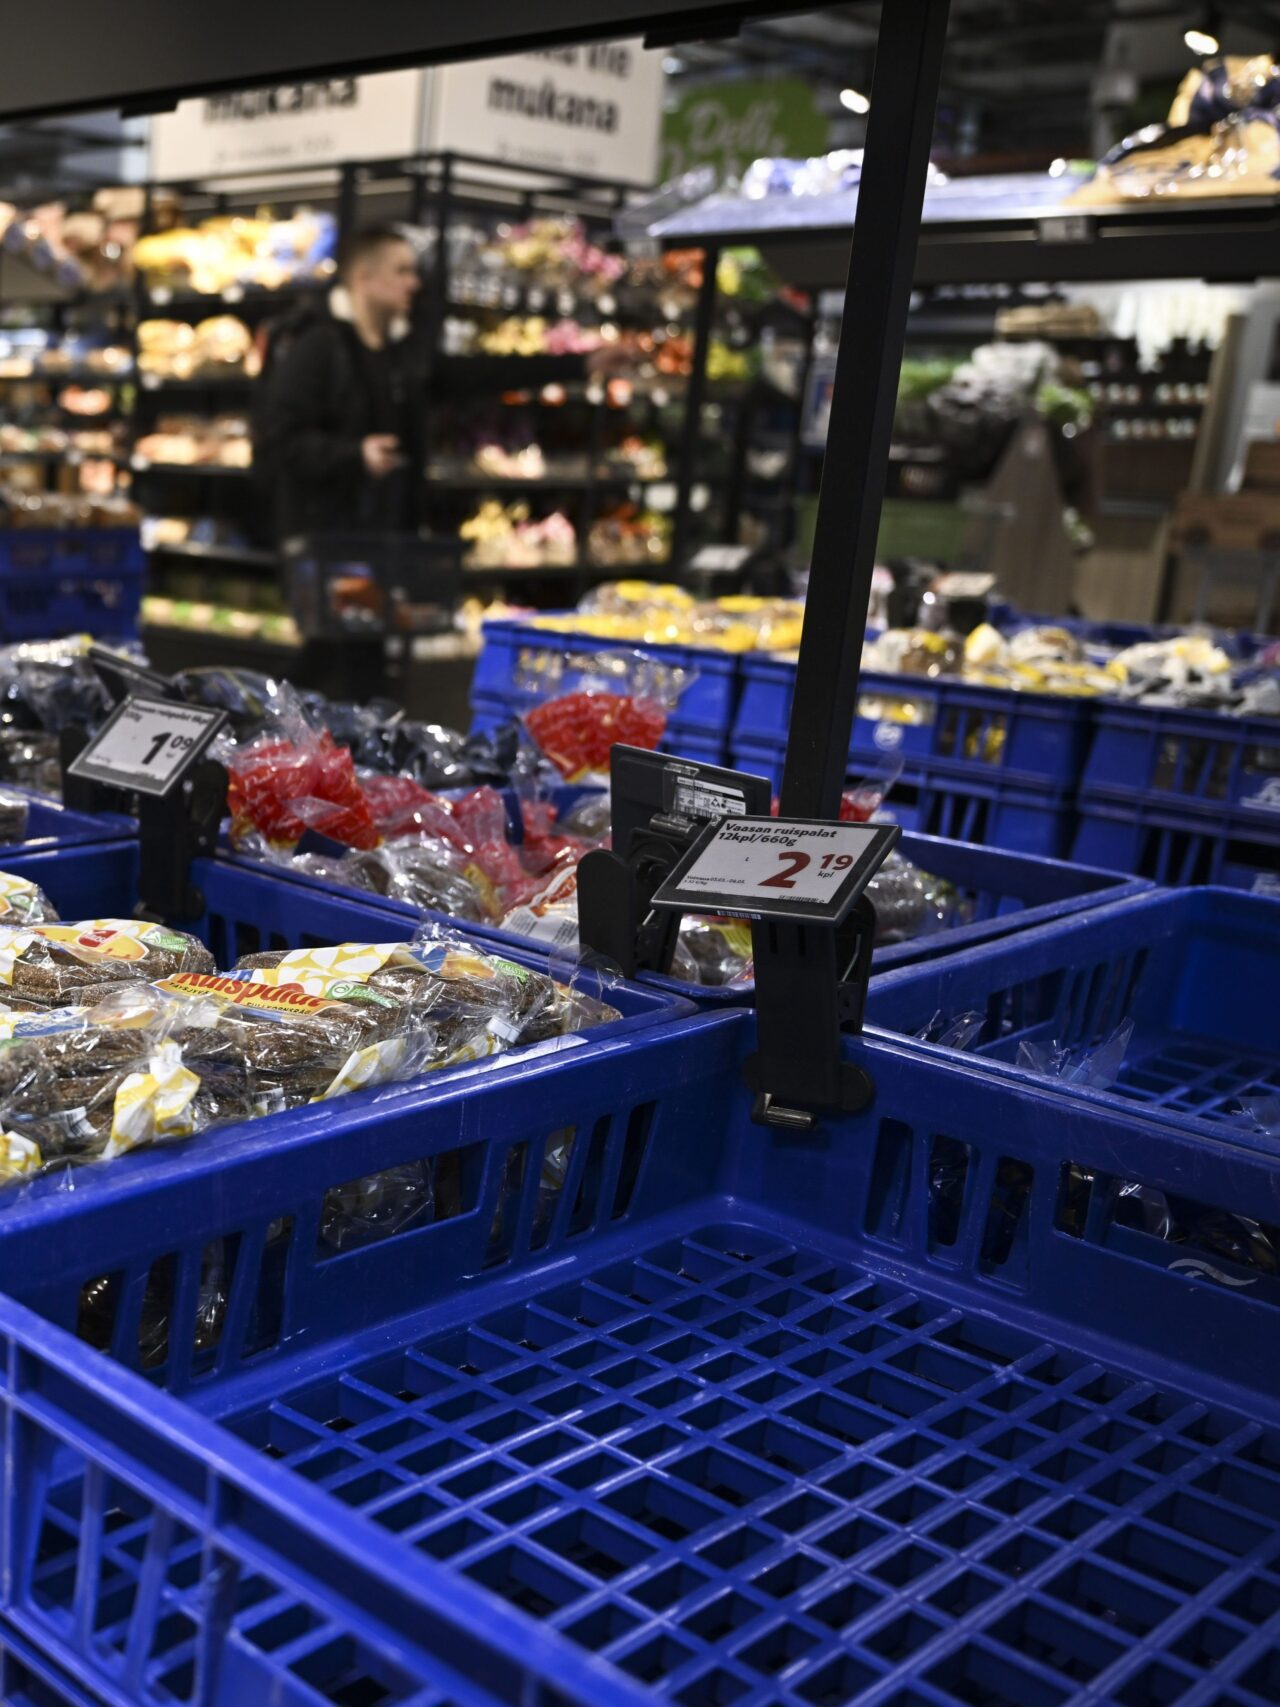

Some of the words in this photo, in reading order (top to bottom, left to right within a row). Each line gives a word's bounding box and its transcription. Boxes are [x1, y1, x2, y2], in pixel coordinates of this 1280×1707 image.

[490, 76, 618, 134] mukana
[141, 731, 173, 766] 1
[171, 735, 194, 751] 09
[718, 831, 798, 848] 12kpl/660g
[725, 823, 772, 834] Vaasan
[773, 827, 838, 839] ruispalat
[757, 851, 812, 889] 2
[820, 853, 854, 871] 19
[817, 870, 836, 879] kpl
